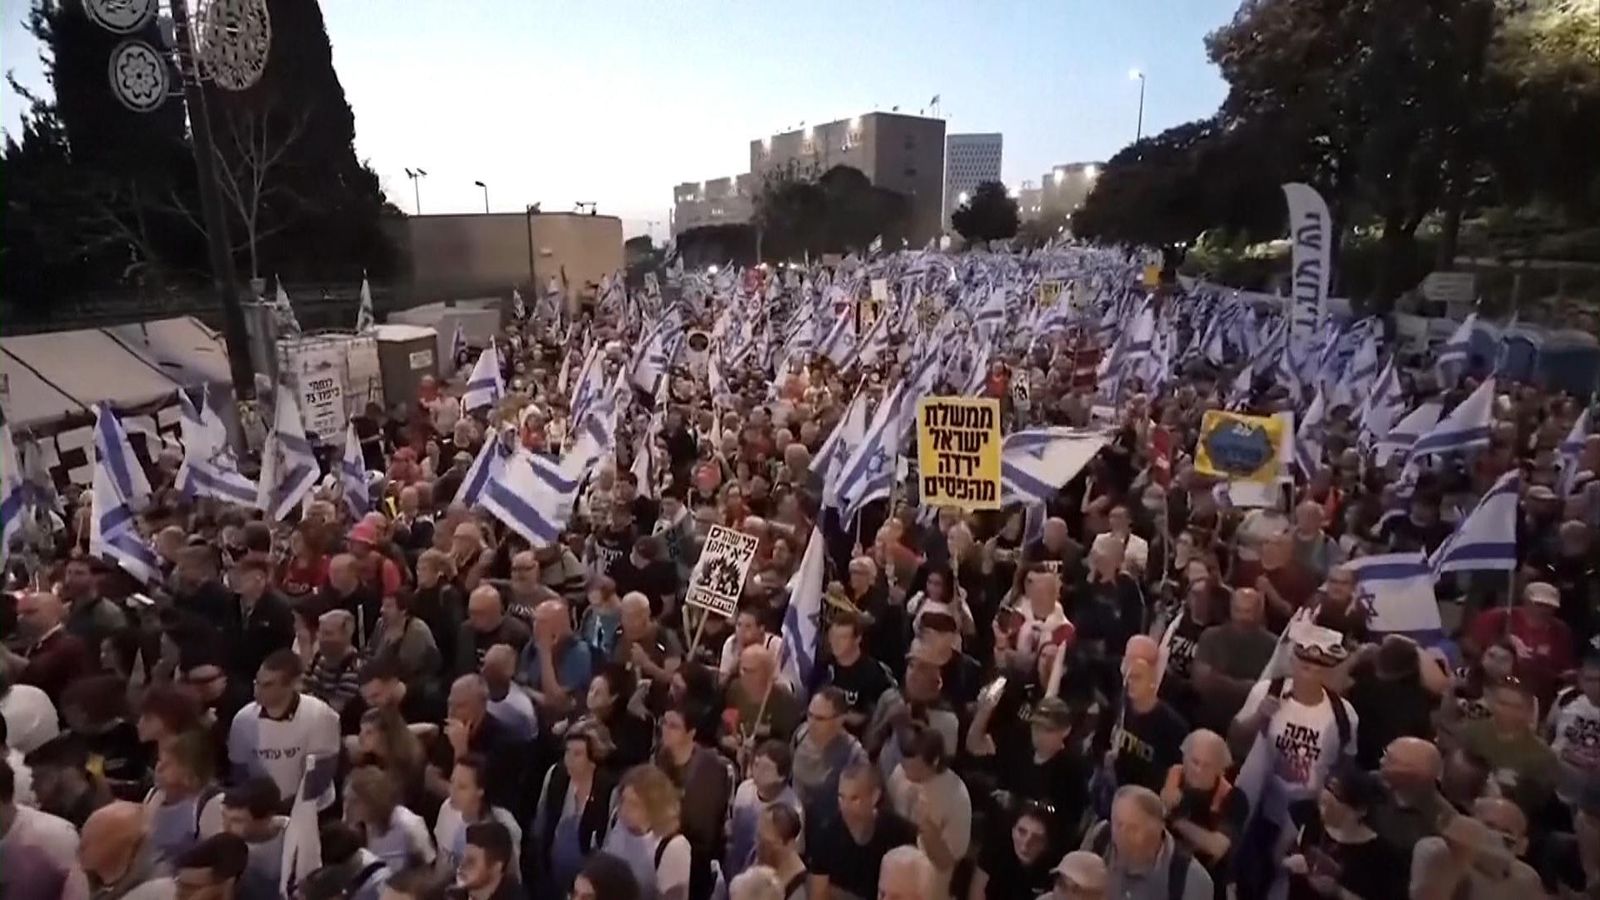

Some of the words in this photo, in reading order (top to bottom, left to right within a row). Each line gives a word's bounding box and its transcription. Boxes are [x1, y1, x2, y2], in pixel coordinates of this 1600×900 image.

[925, 402, 993, 429] ממשלת
[929, 428, 989, 453] ישראל
[938, 453, 980, 477] ירדה
[925, 476, 996, 501] מהפסים
[731, 547, 752, 562] לא
[1285, 722, 1319, 746] אתה
